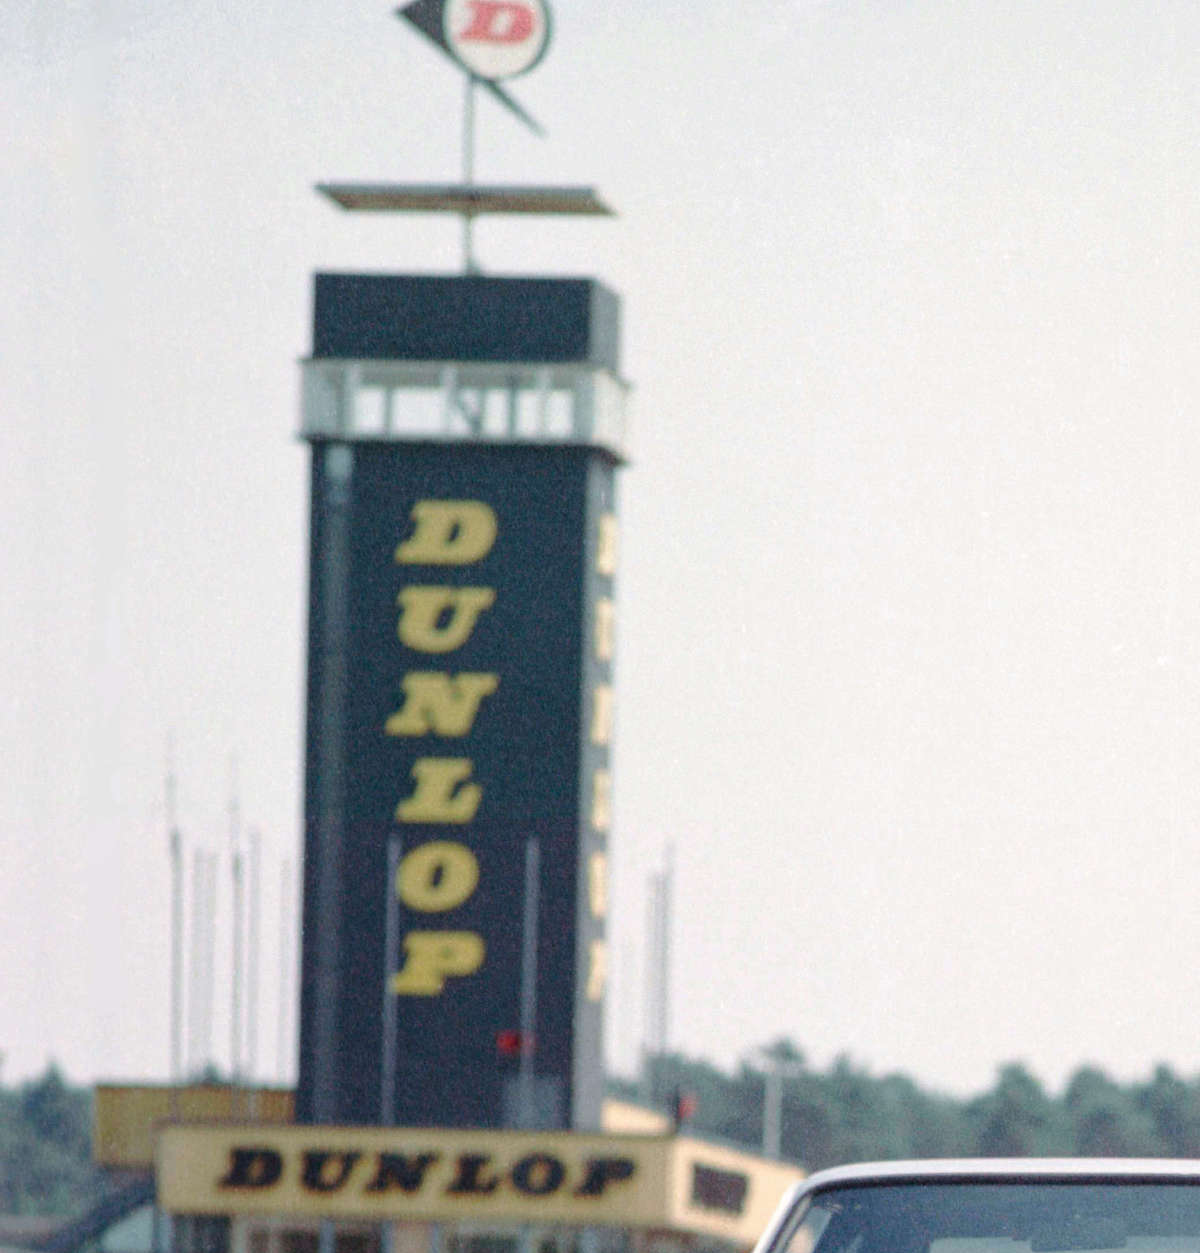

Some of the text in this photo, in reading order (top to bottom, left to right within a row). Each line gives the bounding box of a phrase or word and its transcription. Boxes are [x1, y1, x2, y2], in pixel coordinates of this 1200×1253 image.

[456, 0, 533, 44] D
[386, 499, 499, 997] DUNLOP
[220, 1146, 637, 1197] DUNLOP
